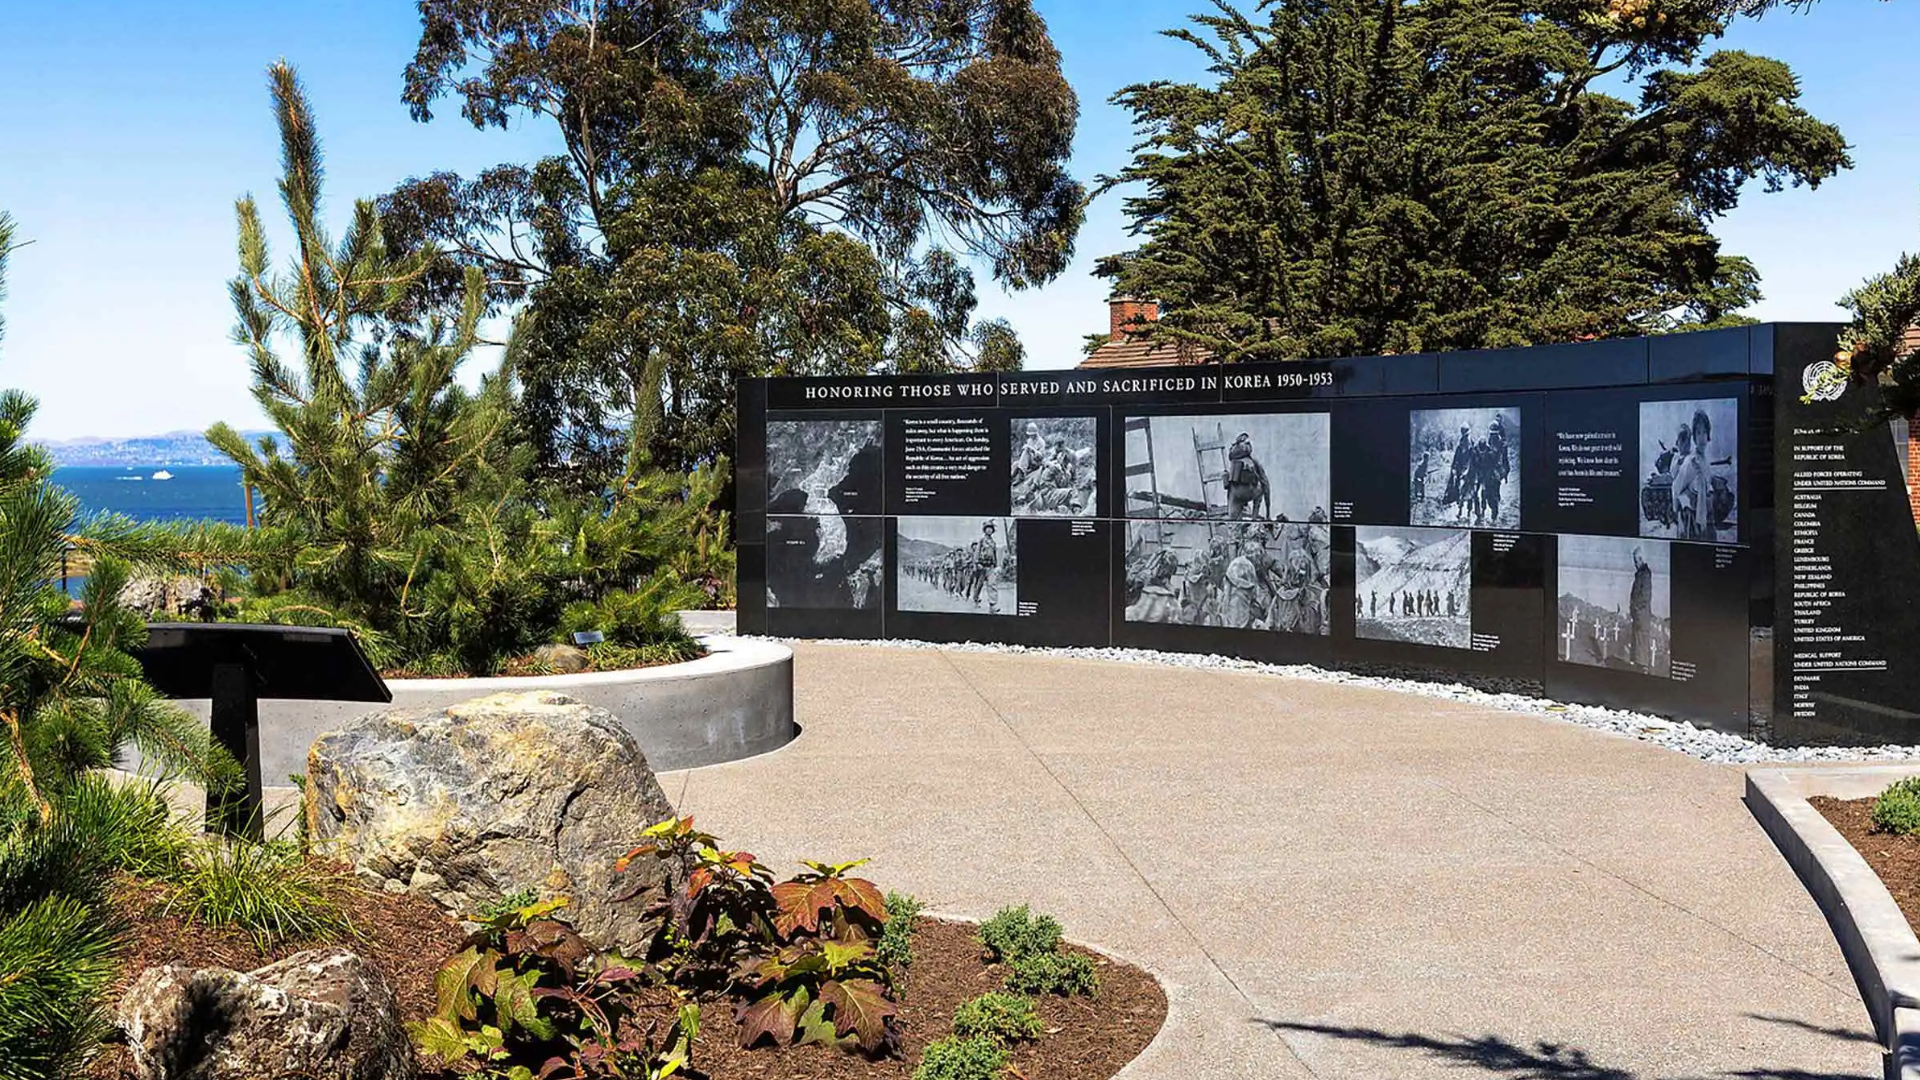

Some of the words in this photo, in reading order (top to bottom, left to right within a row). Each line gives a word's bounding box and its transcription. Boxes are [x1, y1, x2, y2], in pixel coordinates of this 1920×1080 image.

[805, 385, 893, 399] HONORING
[899, 384, 951, 398] THOSE
[957, 383, 994, 396] WHO
[1000, 381, 1060, 395] SERVED
[1066, 380, 1097, 394] AND
[1103, 377, 1196, 393] SACRIFICED
[1201, 376, 1218, 390] IN
[1224, 375, 1271, 389] KOREA
[1277, 372, 1333, 387] 1950-1953
